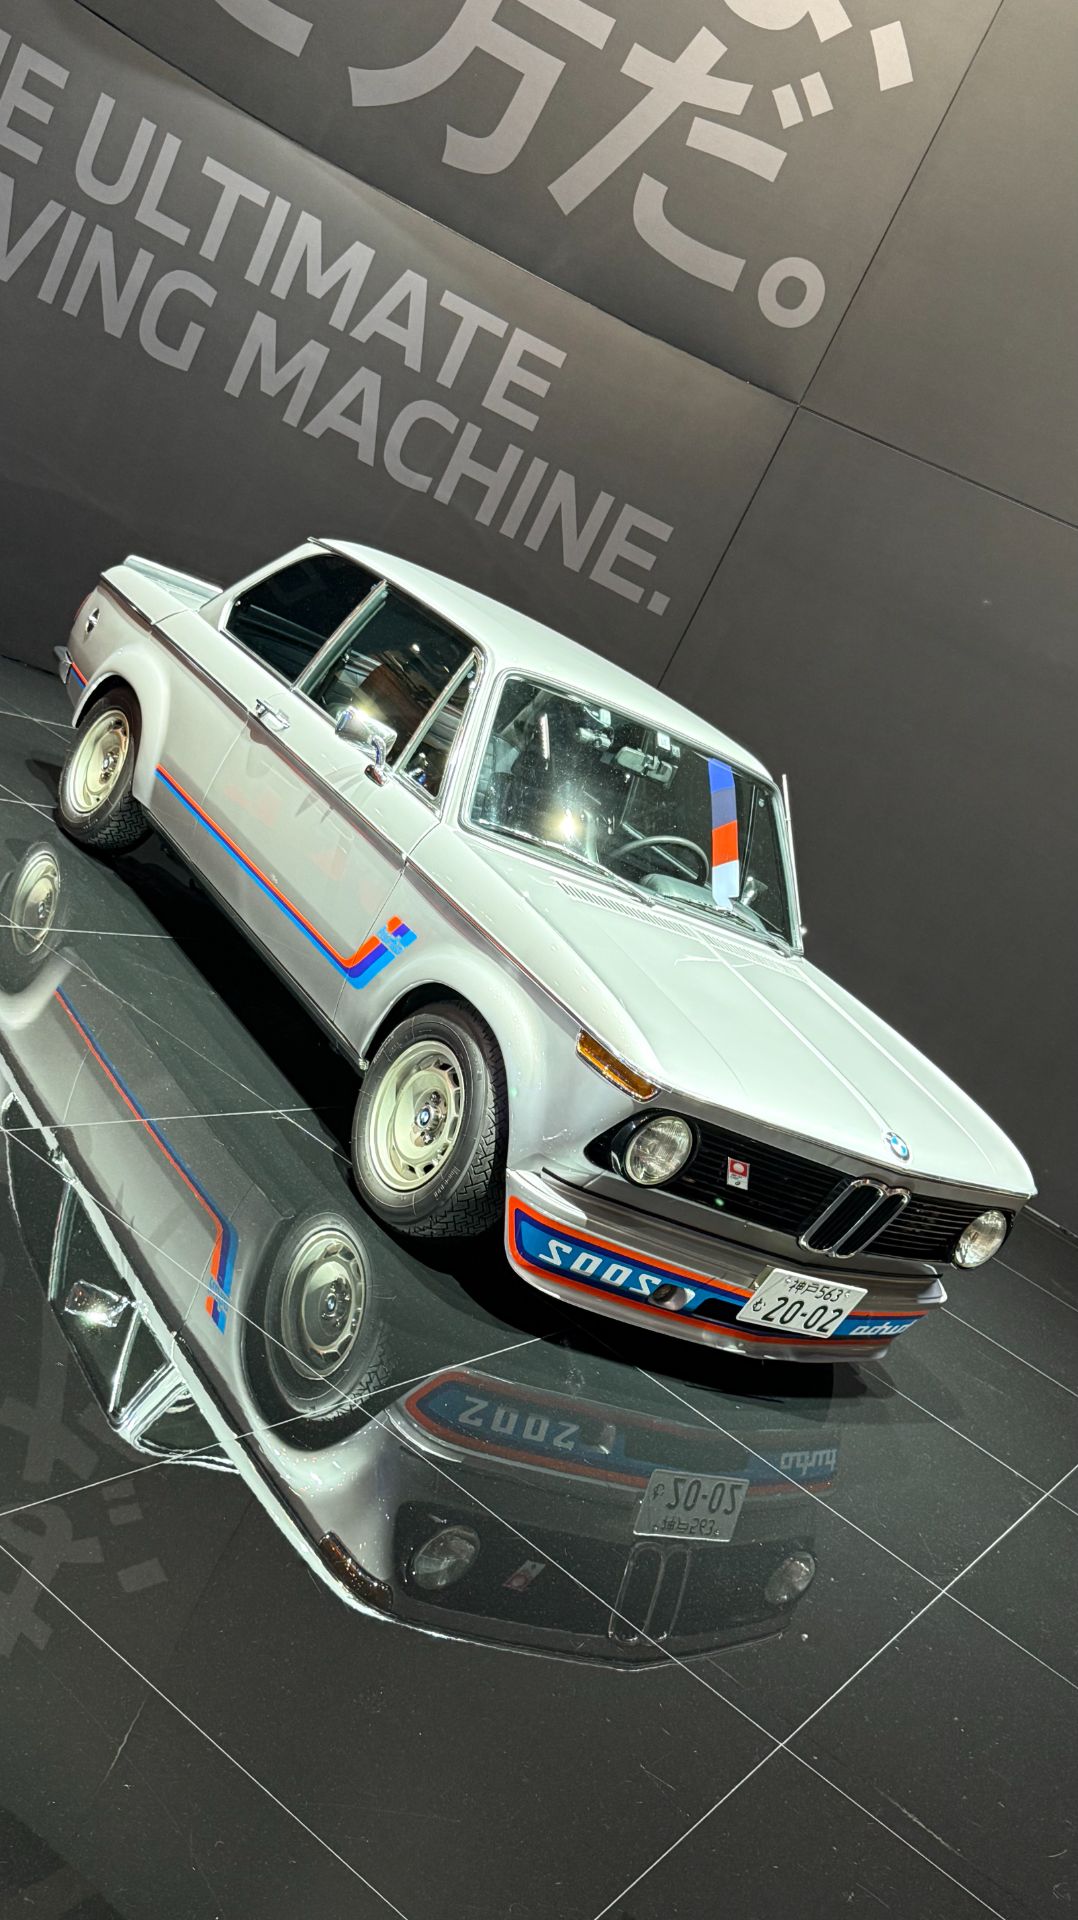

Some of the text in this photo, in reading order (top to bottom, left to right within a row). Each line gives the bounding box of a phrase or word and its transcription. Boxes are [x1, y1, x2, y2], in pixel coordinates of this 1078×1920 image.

[75, 92, 567, 432] ULTIMATE
[224, 310, 674, 616] MACHINE.
[762, 1297, 843, 1332] 20-02
